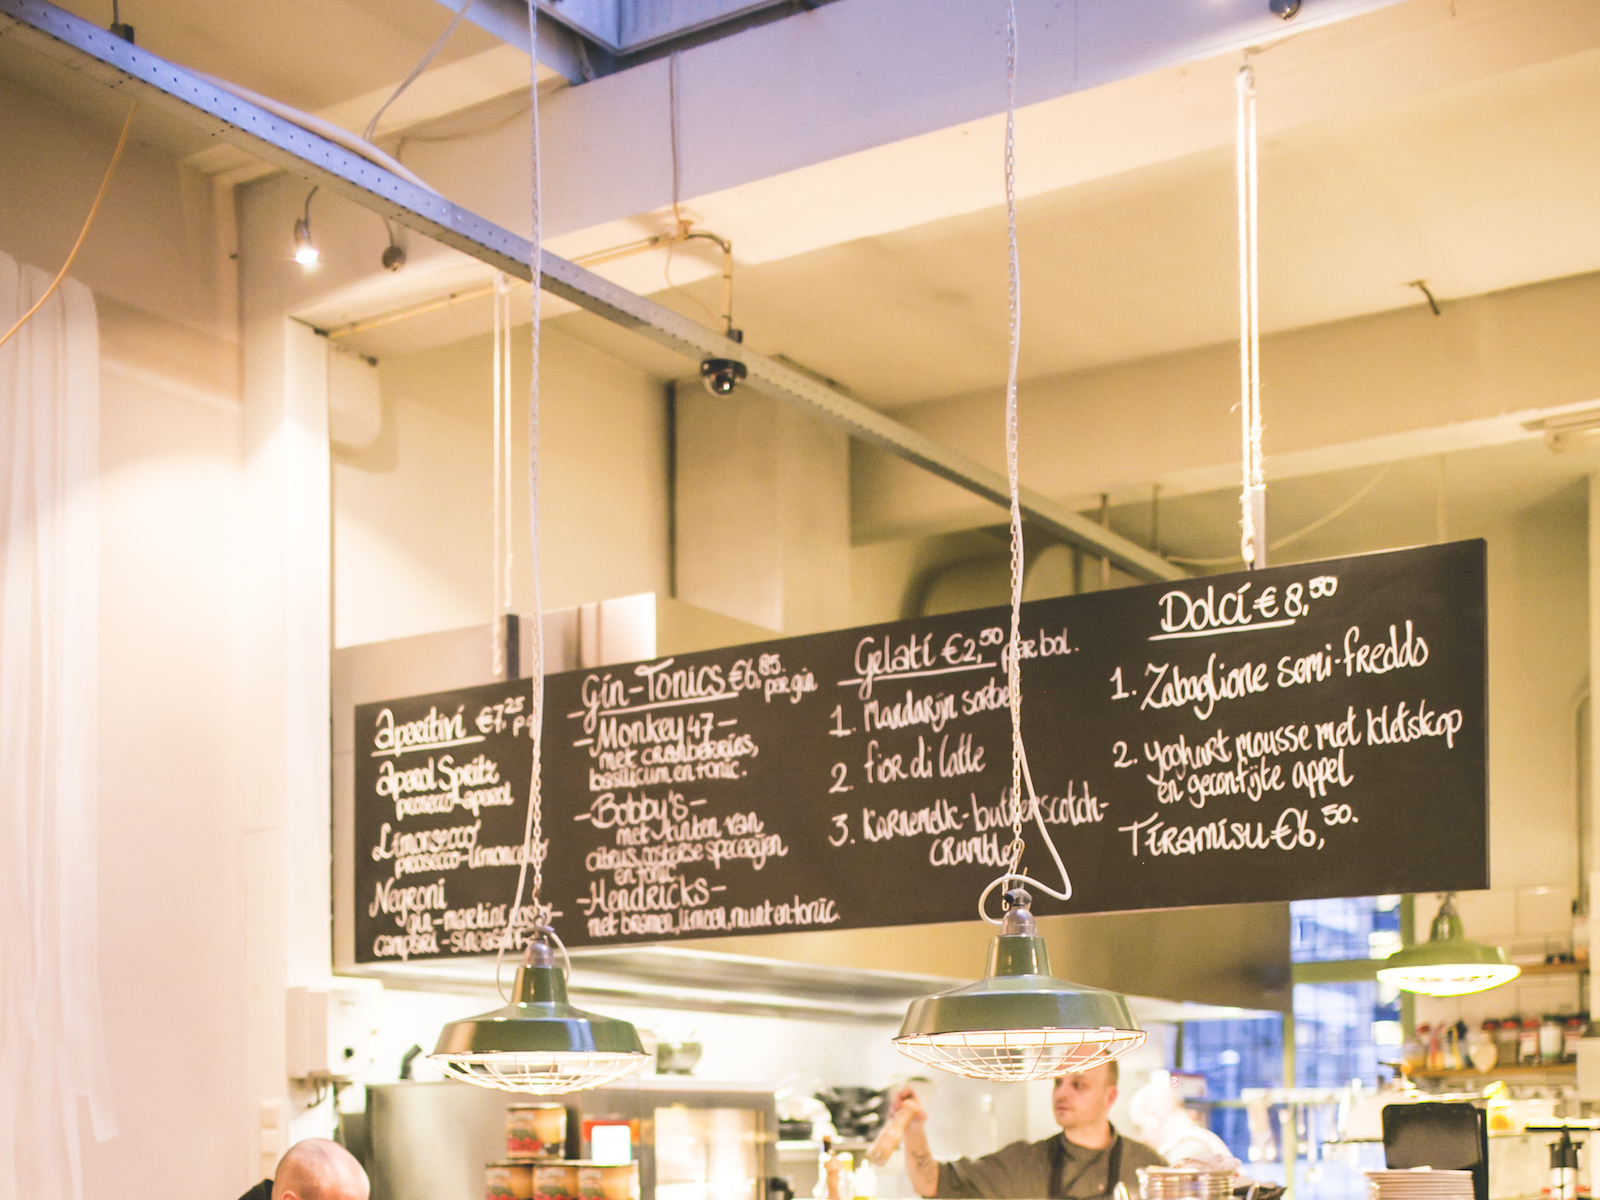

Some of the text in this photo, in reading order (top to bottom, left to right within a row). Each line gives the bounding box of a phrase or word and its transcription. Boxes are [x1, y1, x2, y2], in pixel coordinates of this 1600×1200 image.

[961, 676, 1022, 716] sorbe
[910, 735, 933, 778] di
[1235, 723, 1313, 760] mousse
[1315, 705, 1362, 750] met
[1292, 747, 1355, 798] appel
[369, 877, 448, 928] Negroni
